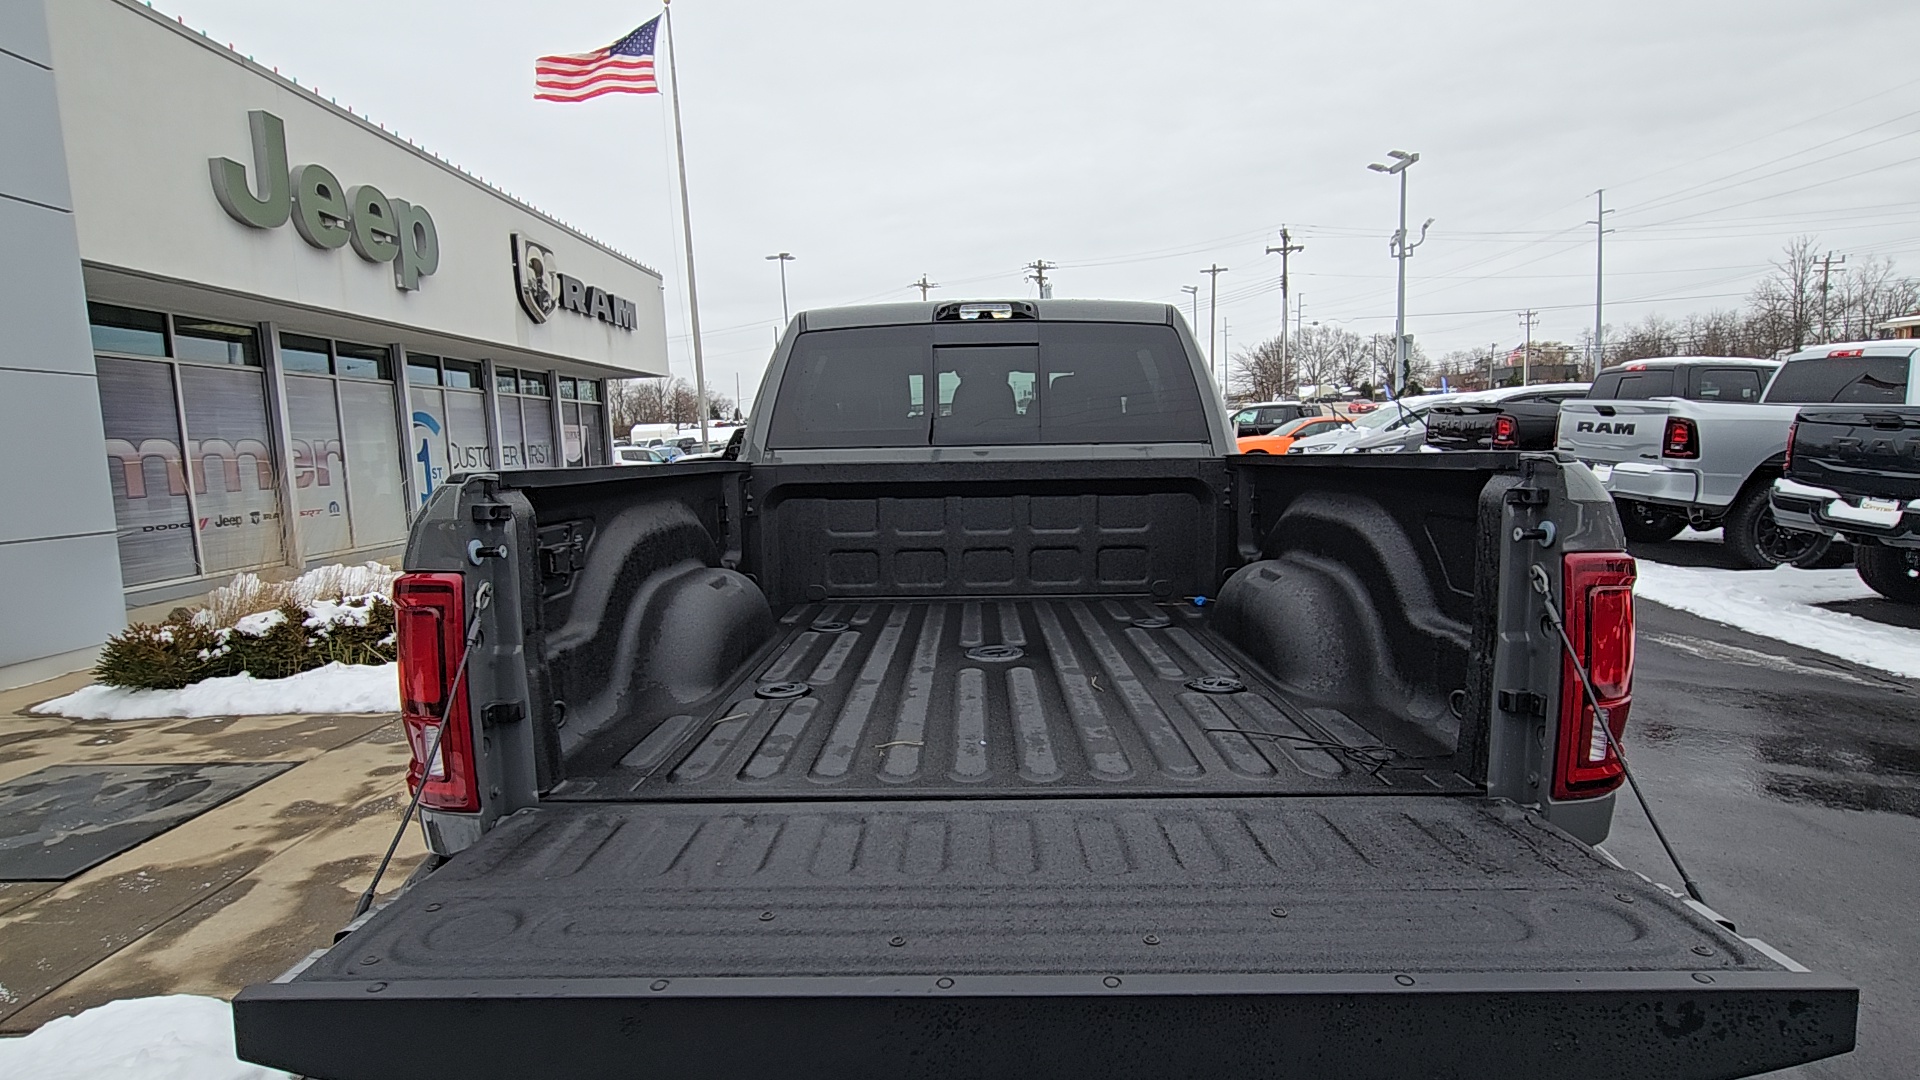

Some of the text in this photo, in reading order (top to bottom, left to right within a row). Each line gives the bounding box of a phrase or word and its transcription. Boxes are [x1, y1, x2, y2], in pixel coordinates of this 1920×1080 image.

[208, 110, 439, 291] Jeep
[557, 273, 638, 331] RAM
[1577, 421, 1636, 436] RAM
[451, 442, 519, 469] CUSTOER
[300, 509, 323, 517] SRT
[143, 522, 192, 533] DODG
[215, 514, 242, 528] Jeep
